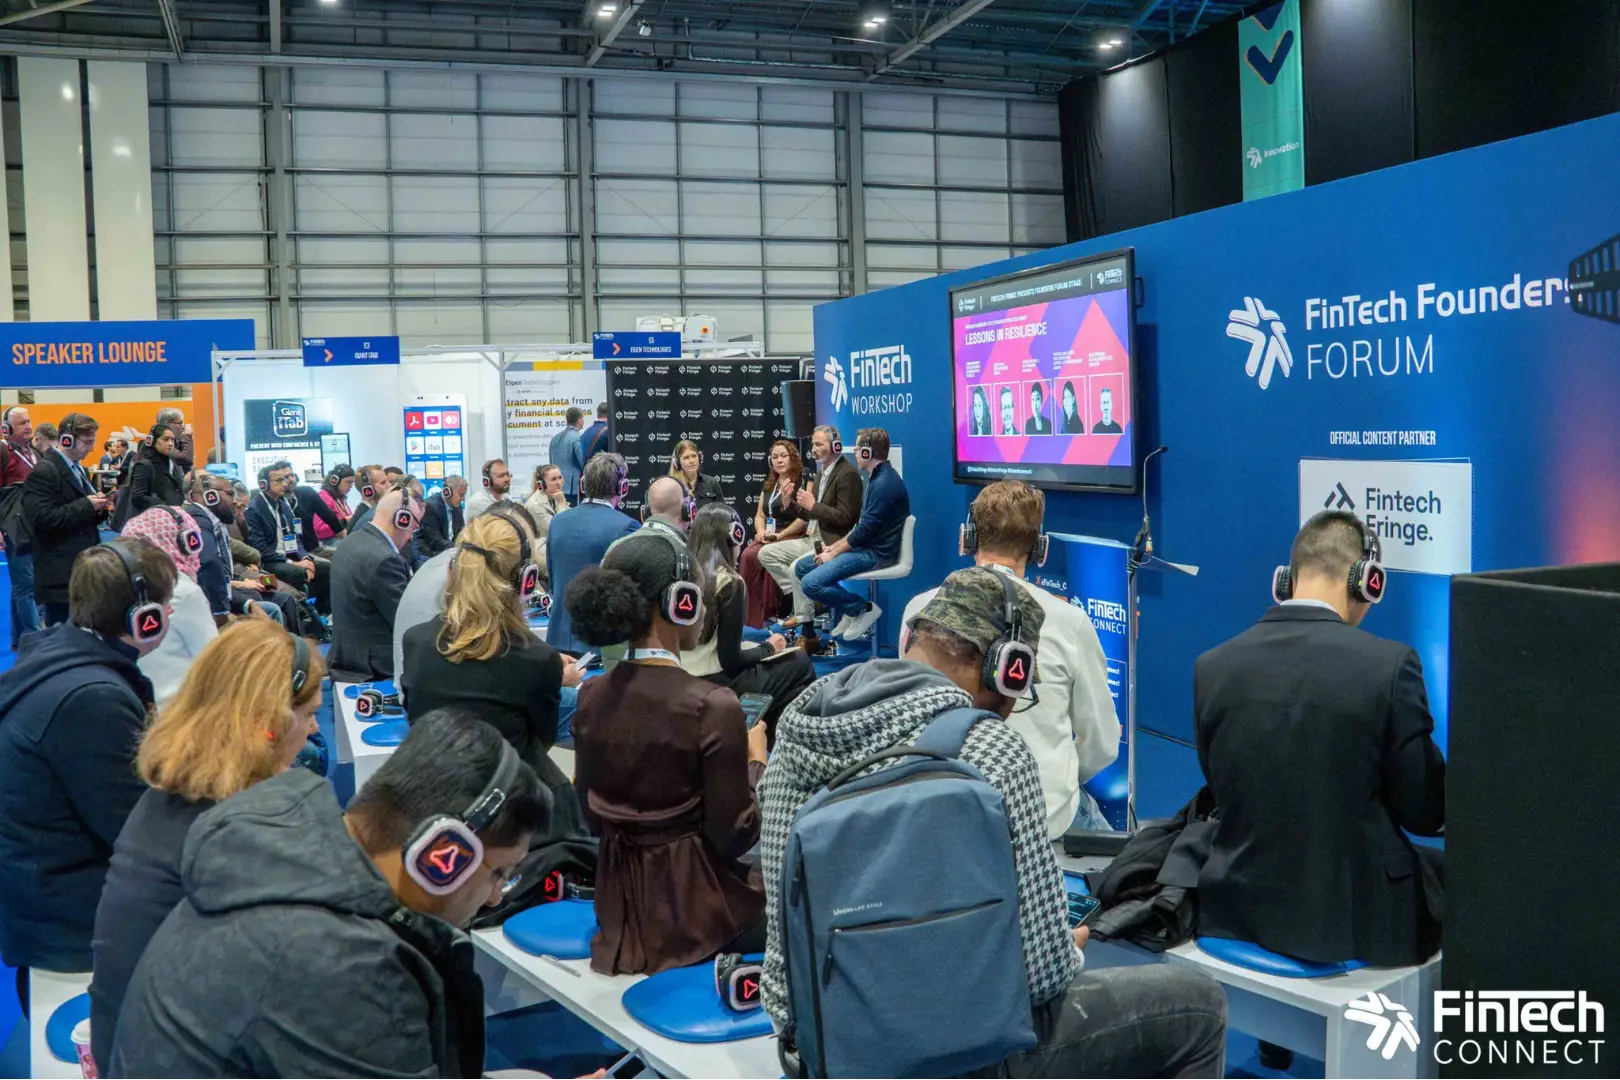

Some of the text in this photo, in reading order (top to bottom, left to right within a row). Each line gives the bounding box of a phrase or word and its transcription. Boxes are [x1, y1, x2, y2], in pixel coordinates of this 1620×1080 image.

[1069, 279, 1082, 288] STAGE
[1305, 272, 1570, 330] FinTech Founder
[965, 330, 996, 346] LESSONS
[996, 328, 1004, 341] IN
[1005, 322, 1047, 340] RESILIENCE
[12, 340, 168, 365] SPEAKER LOUNGE
[1307, 334, 1434, 380] FORUM
[850, 344, 912, 388] FinTech
[281, 408, 301, 416] Giant
[515, 408, 552, 417] financial
[550, 397, 570, 405] data
[572, 396, 593, 404] from
[852, 392, 913, 416] WORKSHOP
[1330, 430, 1436, 445] OFFICIAL CONTENT PARTNER
[1366, 487, 1442, 514] Fintech
[1087, 598, 1126, 622] FinTech
[1090, 618, 1126, 635] ONNECT
